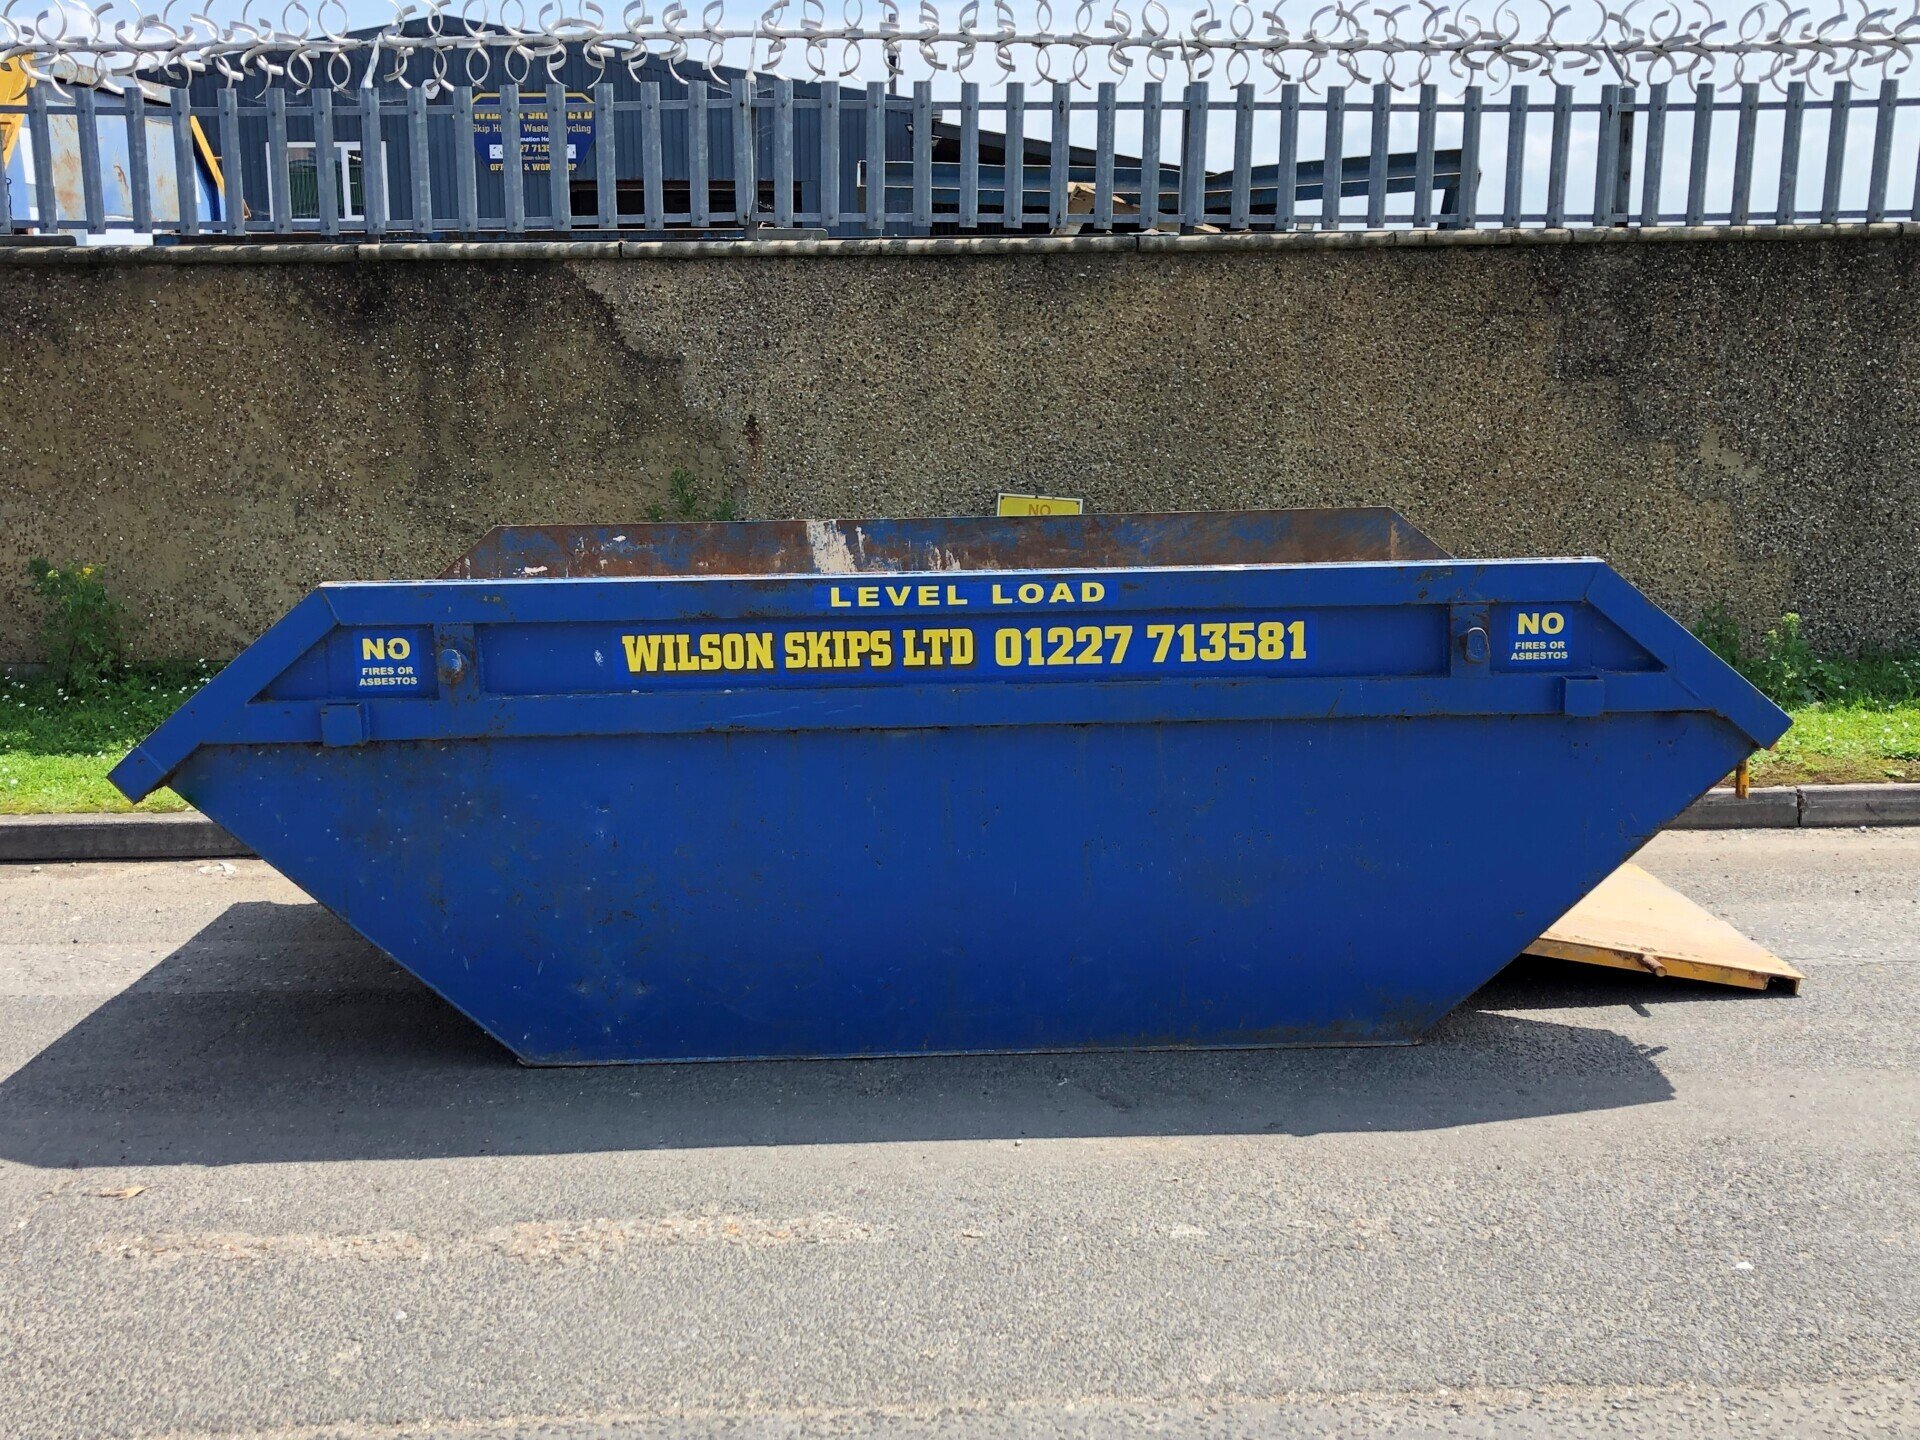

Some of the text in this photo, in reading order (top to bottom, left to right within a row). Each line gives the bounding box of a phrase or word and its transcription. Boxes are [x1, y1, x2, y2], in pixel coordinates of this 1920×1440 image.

[523, 123, 549, 133] Waste
[1028, 503, 1051, 515] NO
[831, 582, 1105, 608] LEVEL LOAD
[1517, 612, 1565, 635] NO
[362, 637, 411, 660] NO
[622, 620, 1307, 673] WILSON SKIPS LTD 01227 713581
[1514, 640, 1566, 650] FIRES OR
[1510, 651, 1568, 661] ASBESTOS
[362, 666, 414, 675] FIRES OR
[359, 676, 418, 686] ASBESTOS
